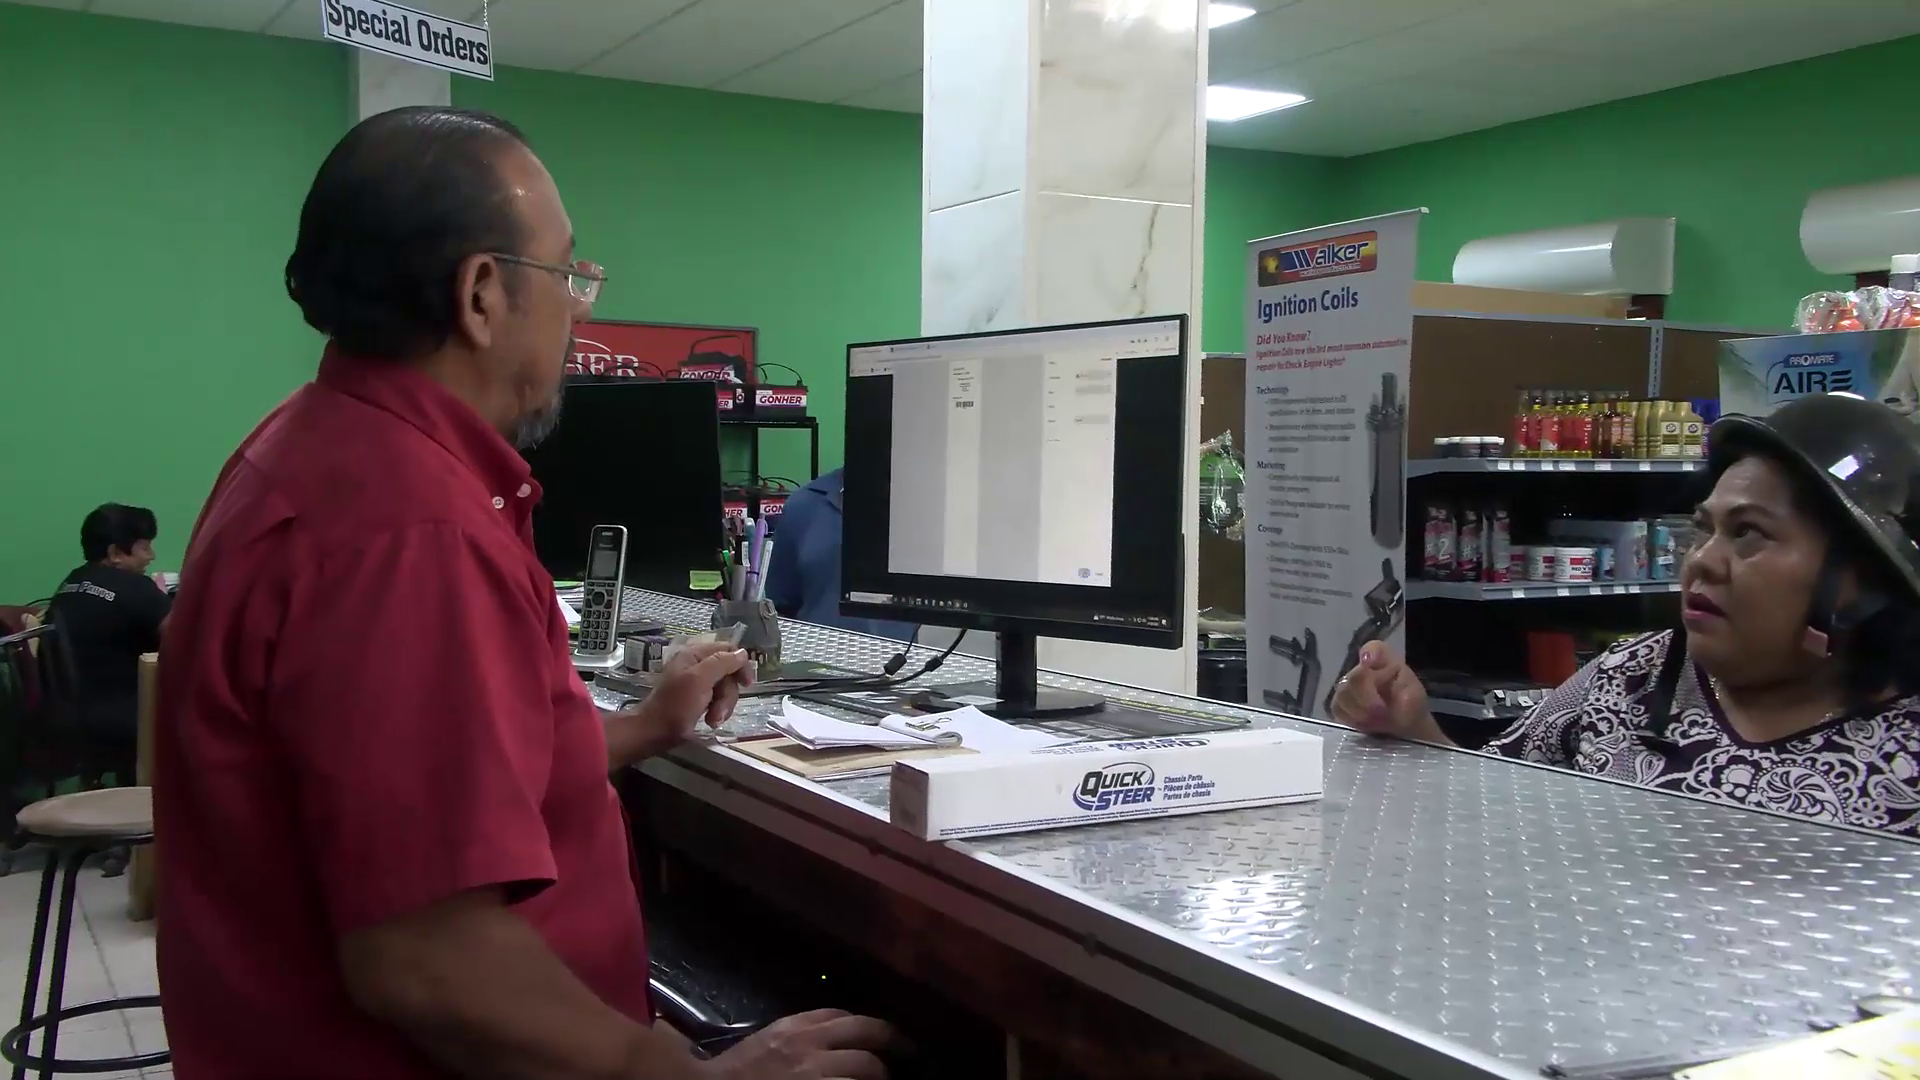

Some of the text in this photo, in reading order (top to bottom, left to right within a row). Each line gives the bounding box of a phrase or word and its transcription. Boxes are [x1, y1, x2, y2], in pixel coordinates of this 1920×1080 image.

[328, 0, 489, 65] Special Orders
[1282, 242, 1369, 271] Walker
[1258, 286, 1359, 324] Ignition Coils
[1257, 330, 1311, 345] Did You Know?
[1774, 369, 1853, 394] AIRE
[760, 395, 802, 404] GONHER
[1080, 770, 1146, 798] QUICK
[1164, 775, 1187, 784] Chassis
[1184, 782, 1192, 790] de
[1094, 786, 1155, 811] STEER
[1183, 791, 1191, 799] de
